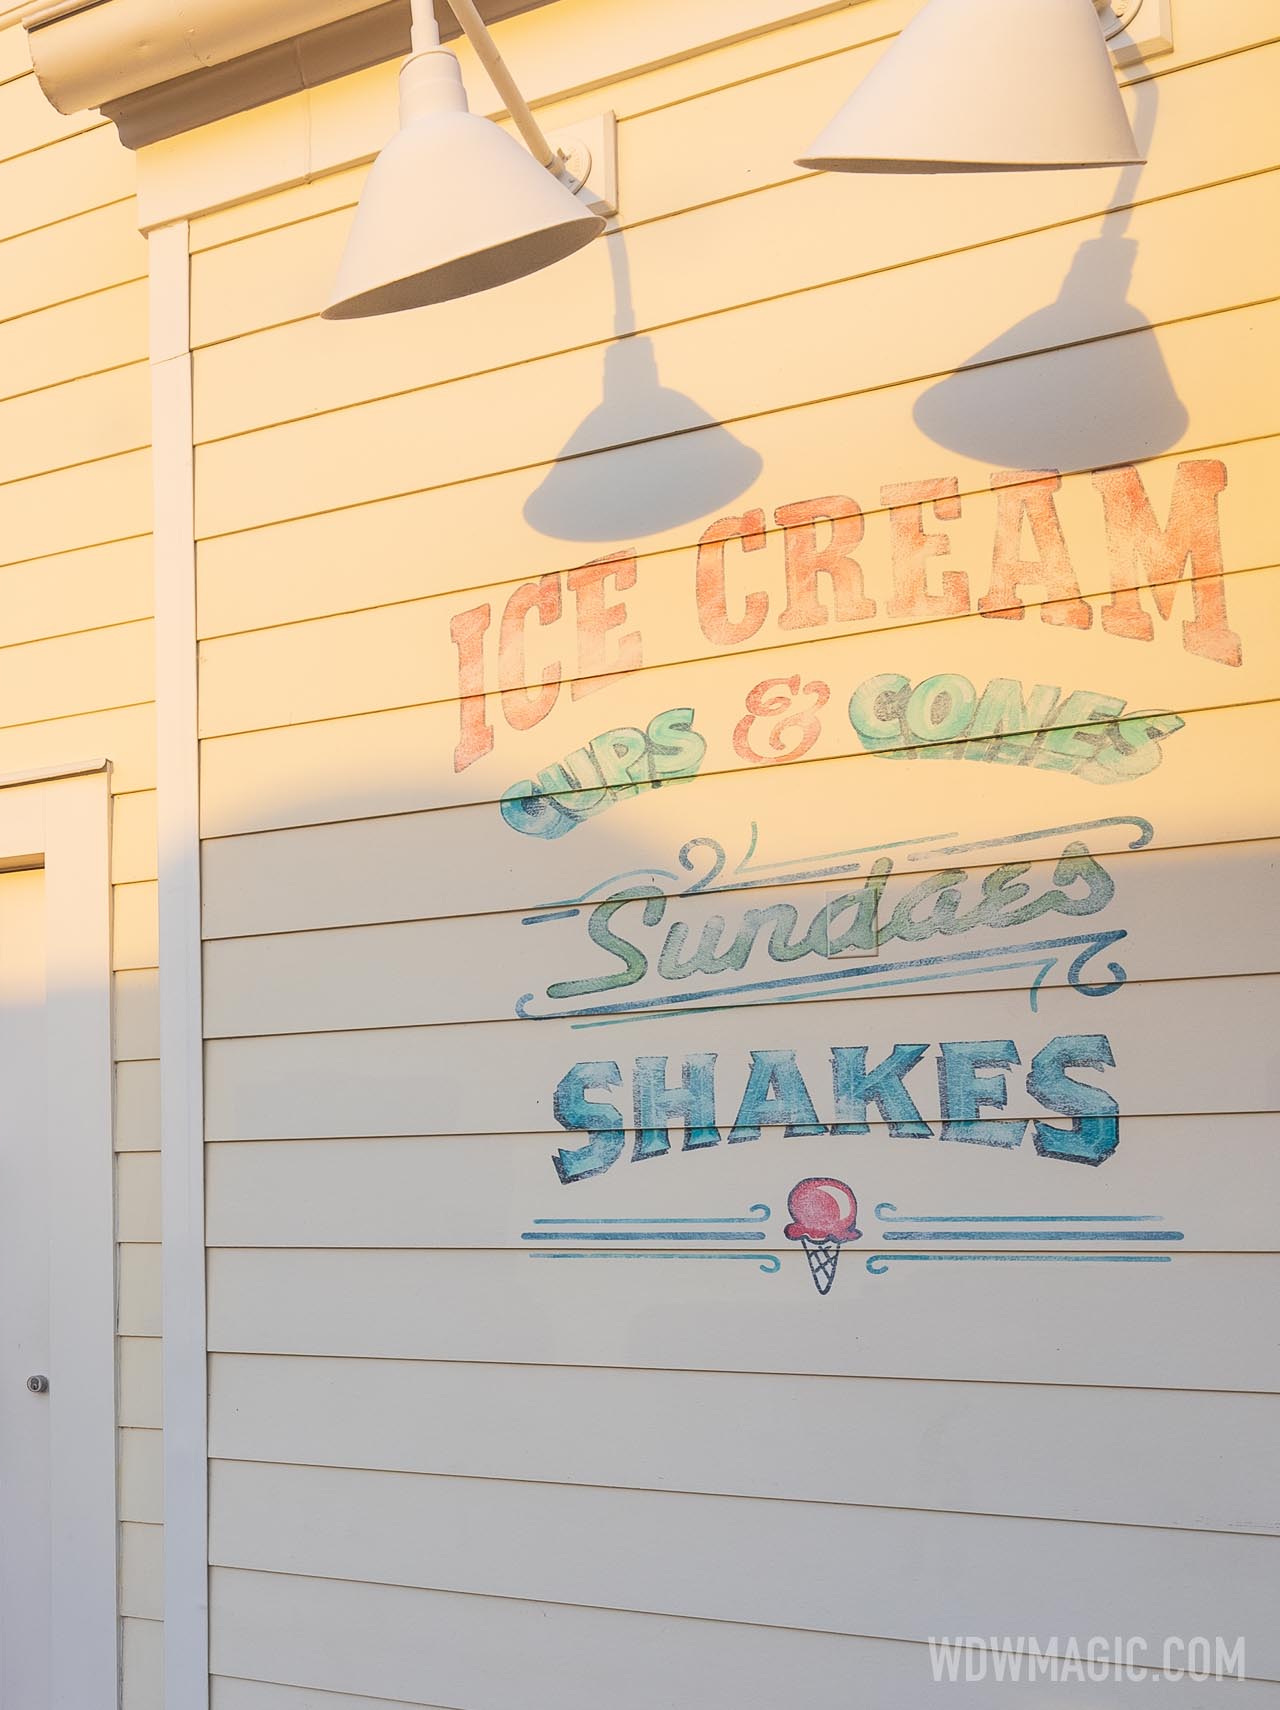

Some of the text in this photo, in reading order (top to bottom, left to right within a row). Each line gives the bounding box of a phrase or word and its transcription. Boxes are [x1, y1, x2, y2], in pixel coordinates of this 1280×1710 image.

[449, 458, 1243, 775] ICE CREAM
[500, 672, 1186, 840] CUPS & CONES
[546, 840, 1116, 999] Sundaes
[551, 1033, 1121, 1185] SHAKES
